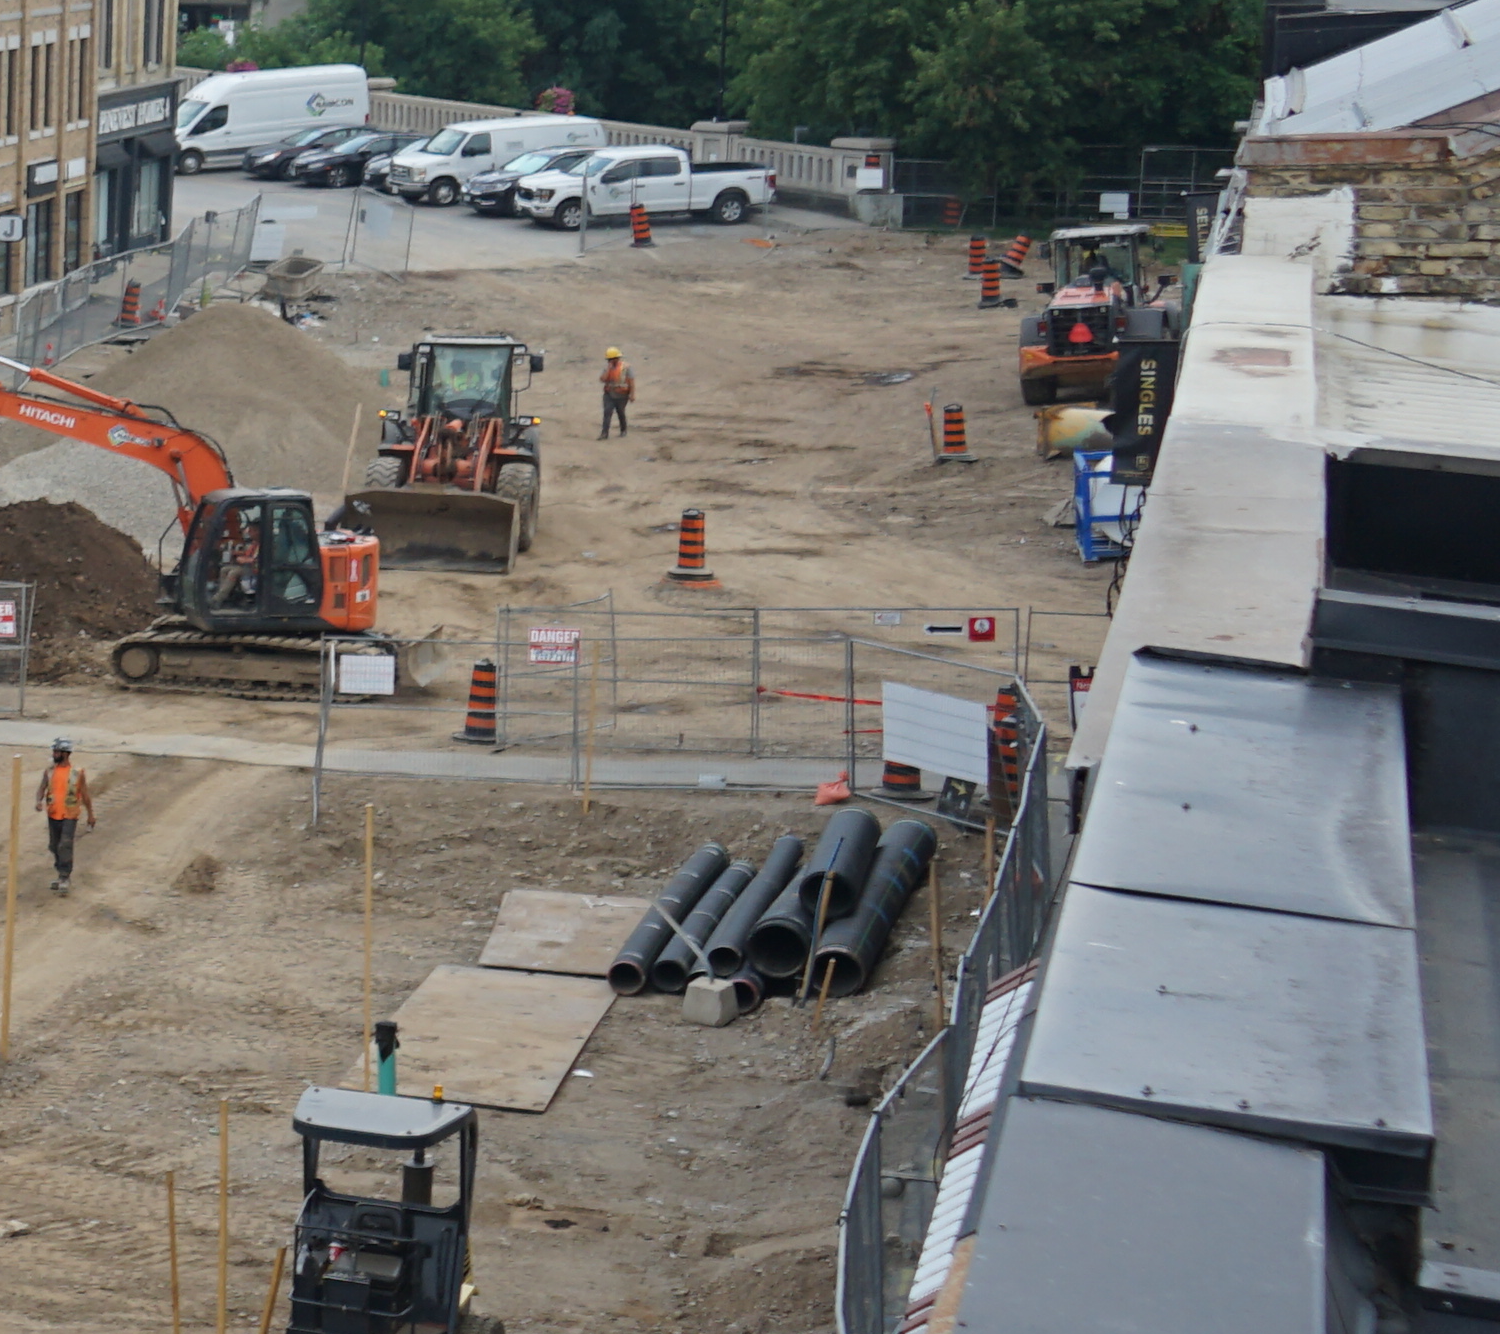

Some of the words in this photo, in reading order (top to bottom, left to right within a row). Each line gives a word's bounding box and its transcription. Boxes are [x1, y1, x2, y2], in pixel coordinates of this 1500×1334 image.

[1137, 358, 1157, 436] SINGLES
[19, 404, 76, 429] HITACHI
[531, 630, 580, 644] DANGER
